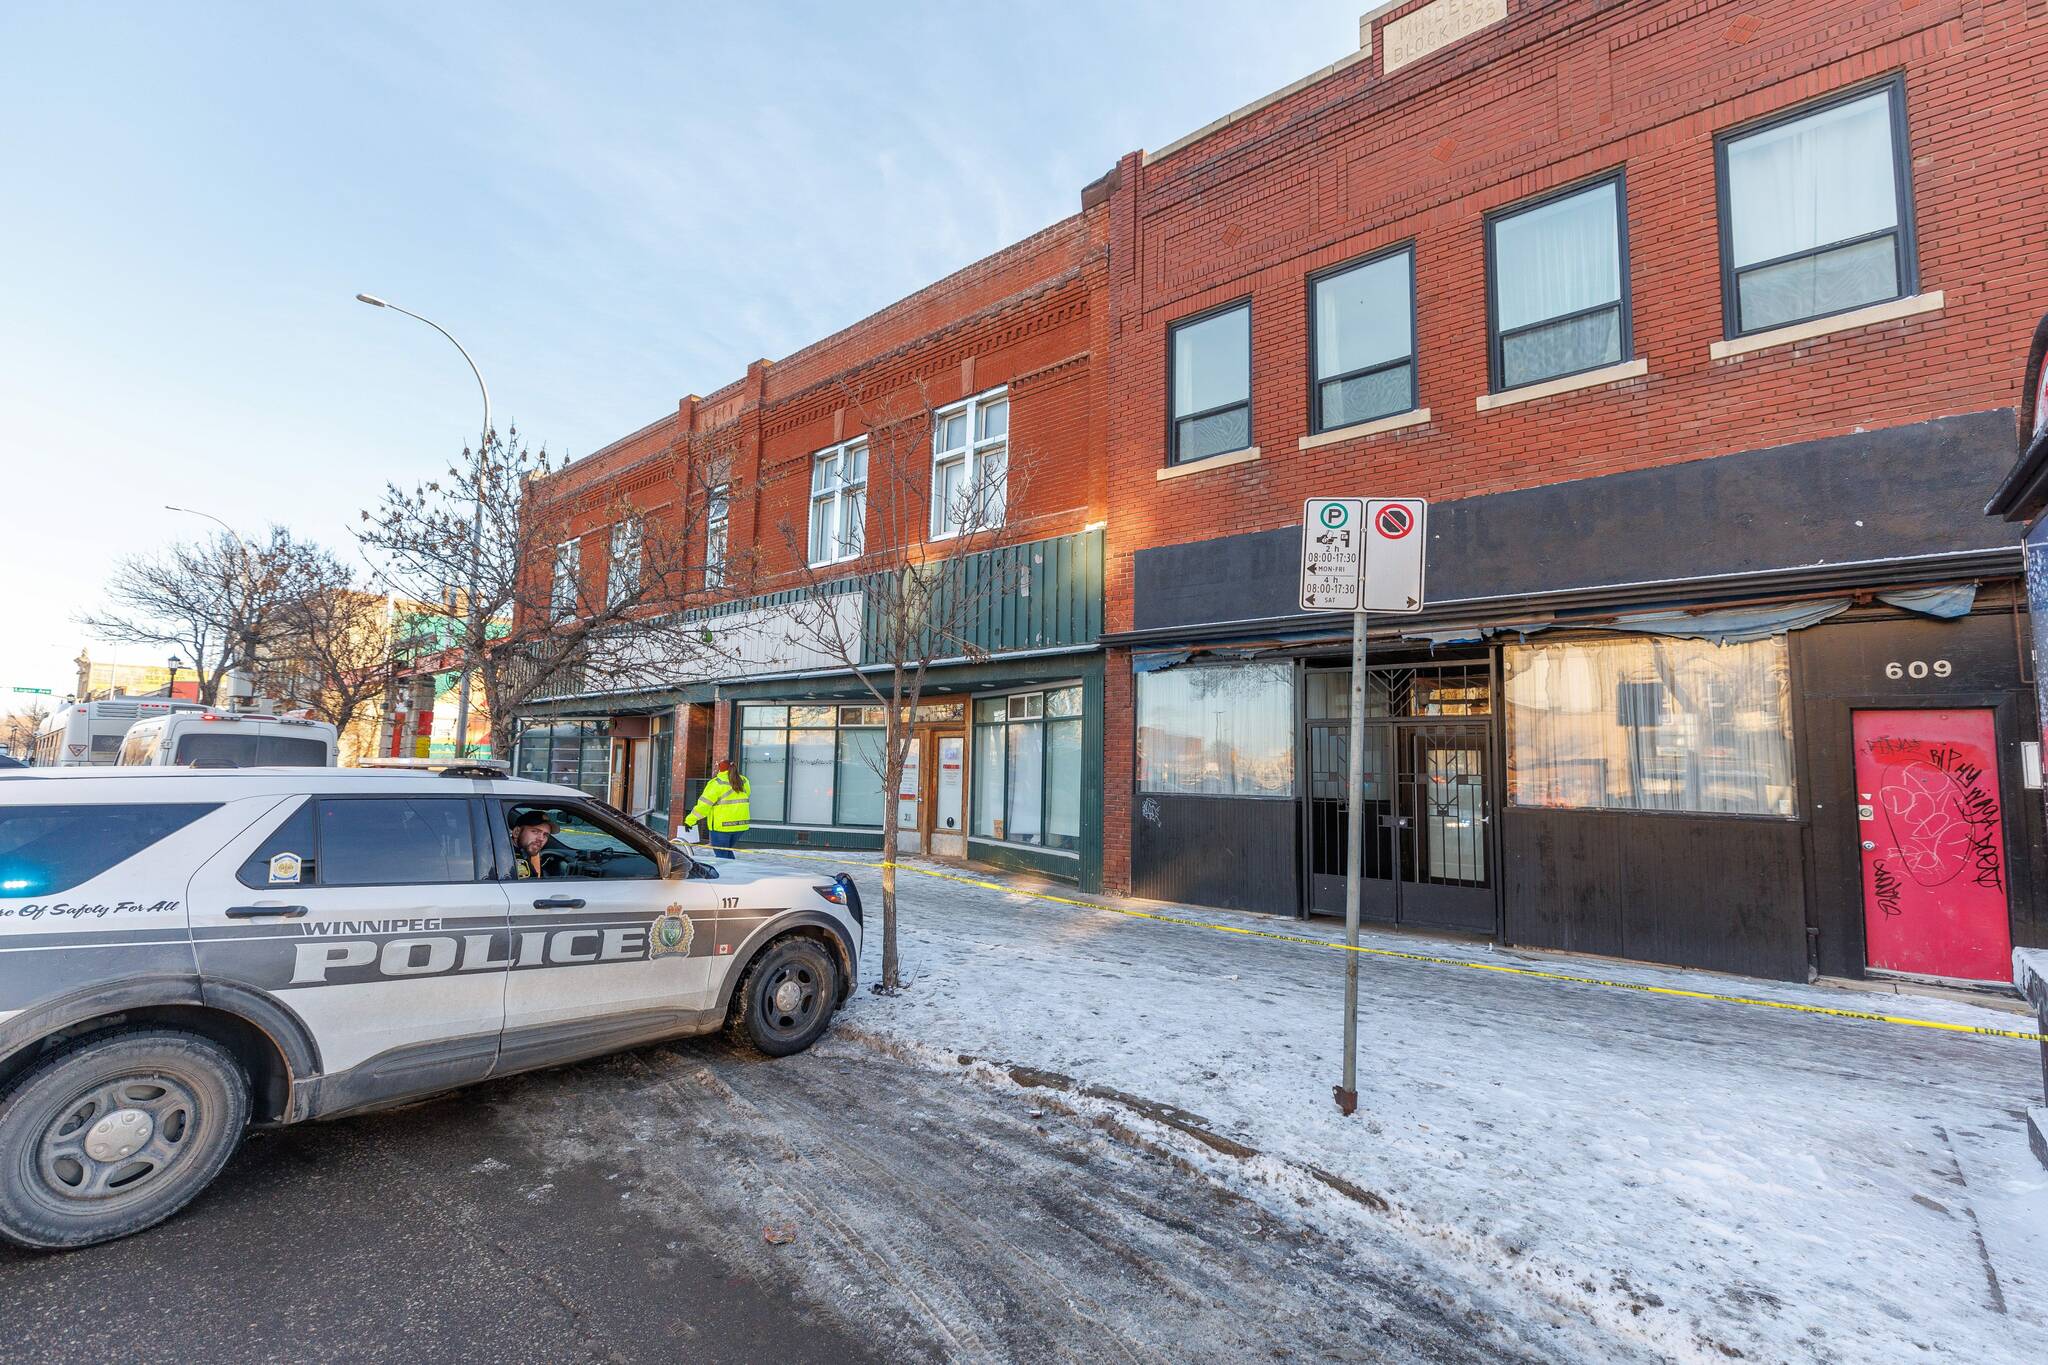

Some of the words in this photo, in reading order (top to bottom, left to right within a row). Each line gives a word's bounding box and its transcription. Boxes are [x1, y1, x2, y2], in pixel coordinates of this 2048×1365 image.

[1394, 24, 1450, 63] BLOCK
[1328, 508, 1342, 523] P
[1308, 552, 1357, 563] 08:00-17:30
[1318, 565, 1346, 573] MON-FRI
[1333, 576, 1339, 584] h
[1306, 583, 1355, 594] 08:00-17:30
[1885, 659, 1952, 680] 609
[18, 904, 48, 920] Of
[50, 903, 110, 918] Safety
[113, 901, 145, 914] For
[146, 900, 180, 913] All
[722, 897, 739, 909] 117
[302, 918, 442, 936] WINNIPEG
[289, 927, 647, 985] POLICE
